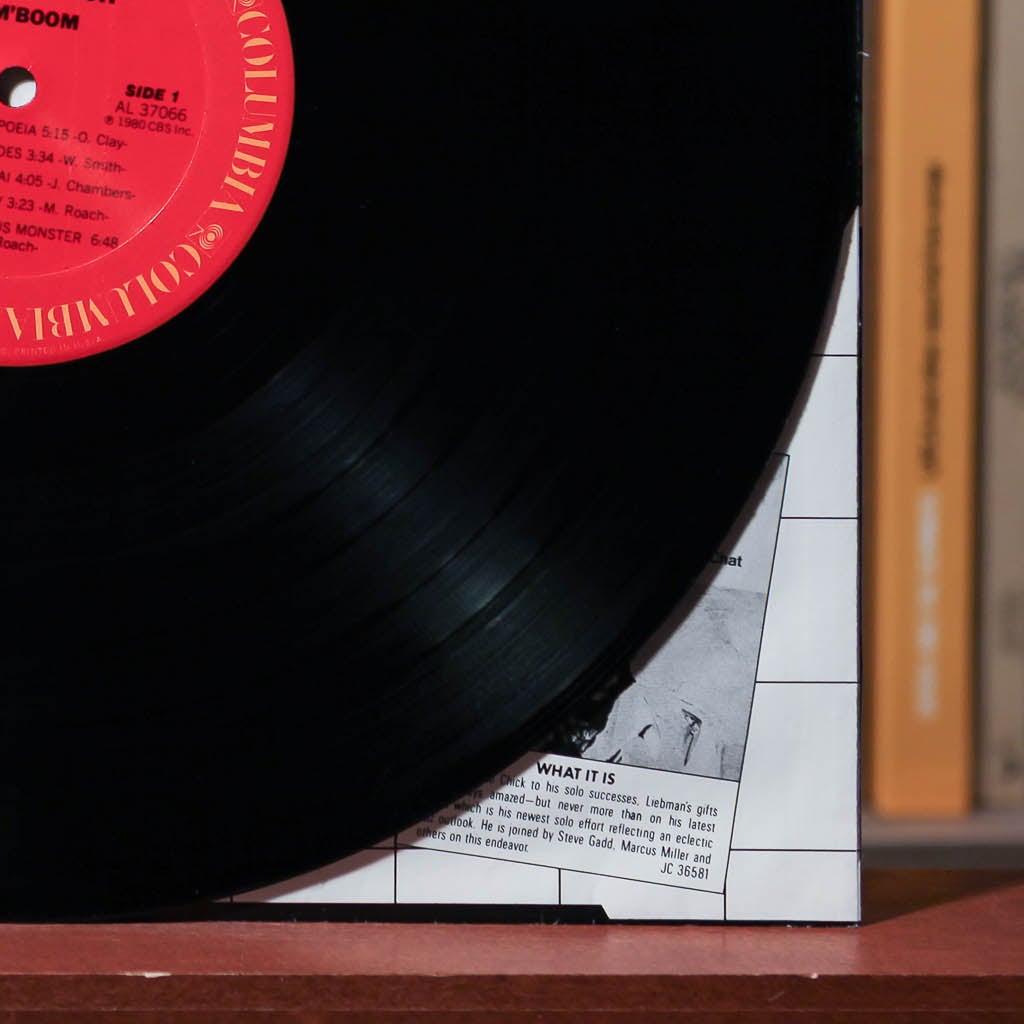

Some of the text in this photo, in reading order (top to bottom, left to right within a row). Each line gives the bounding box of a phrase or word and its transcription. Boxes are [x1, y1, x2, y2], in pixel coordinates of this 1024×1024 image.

[125, 84, 180, 103] SIDE 1
[115, 101, 188, 122] AL 37066
[209, 10, 277, 213] COLUMBIA
[118, 116, 146, 129] 1980
[148, 119, 172, 134] CBS
[26, 149, 54, 163] 3:34
[15, 173, 43, 188] 4:05
[7, 197, 34, 212] 3:23
[65, 204, 110, 221] Roach-
[15, 223, 82, 243] MONSTER
[90, 233, 119, 248] 6:48
[6, 244, 201, 341] COLUMBIA
[536, 761, 615, 785] WHAT IT IS
[531, 780, 540, 791] to
[546, 781, 559, 794] his
[564, 785, 584, 797] solo
[645, 795, 692, 813] Liebman's
[697, 803, 718, 818] gifts
[486, 806, 493, 816] is
[498, 806, 512, 819] his
[516, 810, 550, 825] newest
[554, 815, 574, 826] solo
[578, 818, 604, 833] effort
[609, 821, 655, 842] reflecting
[659, 831, 671, 842] an
[675, 832, 713, 849] eclectic
[558, 800, 583, 812] never
[590, 804, 614, 817] more
[621, 808, 642, 821] than
[650, 814, 662, 824] on
[669, 815, 682, 827] his
[688, 818, 716, 833] latest
[449, 832, 462, 843] on
[465, 833, 482, 846] this
[485, 838, 529, 853] endeavor.
[481, 819, 493, 832] He
[497, 823, 505, 833] is
[509, 823, 539, 838] joined
[542, 827, 554, 842] by
[558, 830, 584, 845] Steve
[621, 839, 657, 856] Marcus
[660, 845, 689, 861] Miller
[693, 852, 712, 865] and
[660, 862, 709, 880] JC 36581
